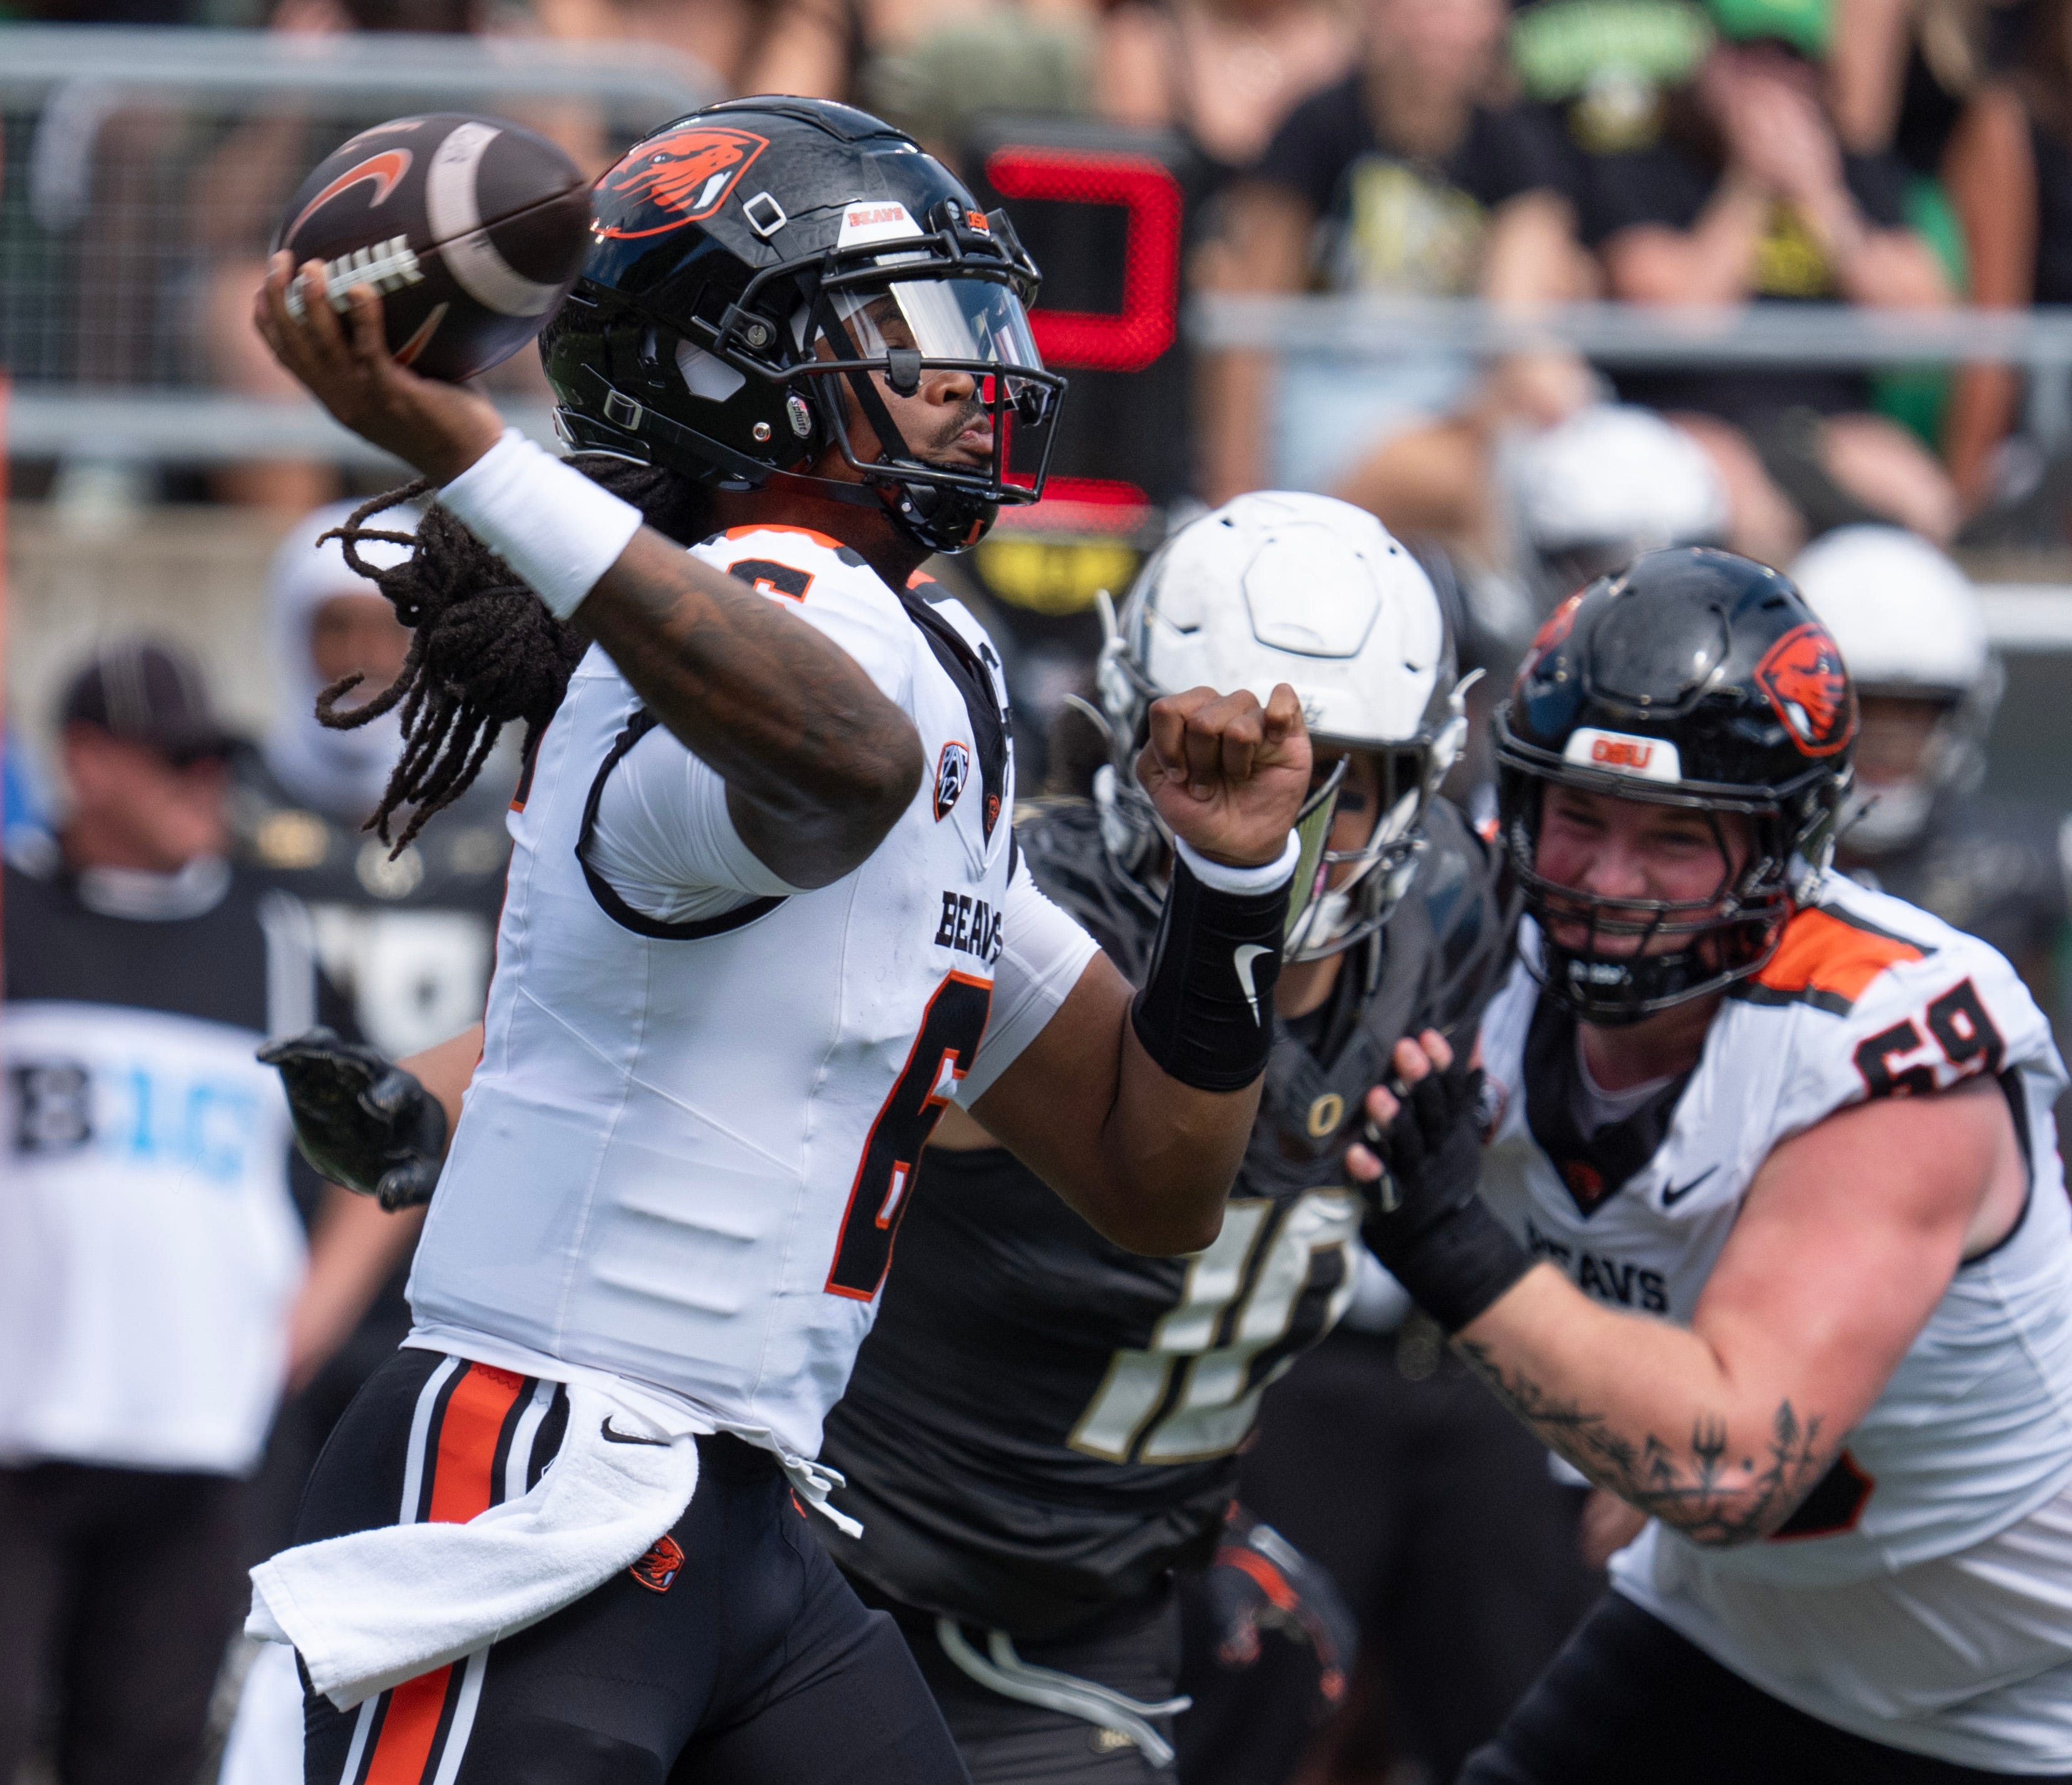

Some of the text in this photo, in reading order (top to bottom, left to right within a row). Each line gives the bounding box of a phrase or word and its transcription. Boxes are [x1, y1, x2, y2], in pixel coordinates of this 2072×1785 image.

[848, 207, 905, 227] BEAVS
[791, 401, 807, 431] schutt
[938, 776, 958, 806] 12
[940, 745, 968, 793] PAC
[934, 890, 1003, 965] BEAVS
[824, 969, 994, 1302] 6
[1525, 1217, 1669, 1312] AVS
[1067, 1186, 1365, 1465] 10
